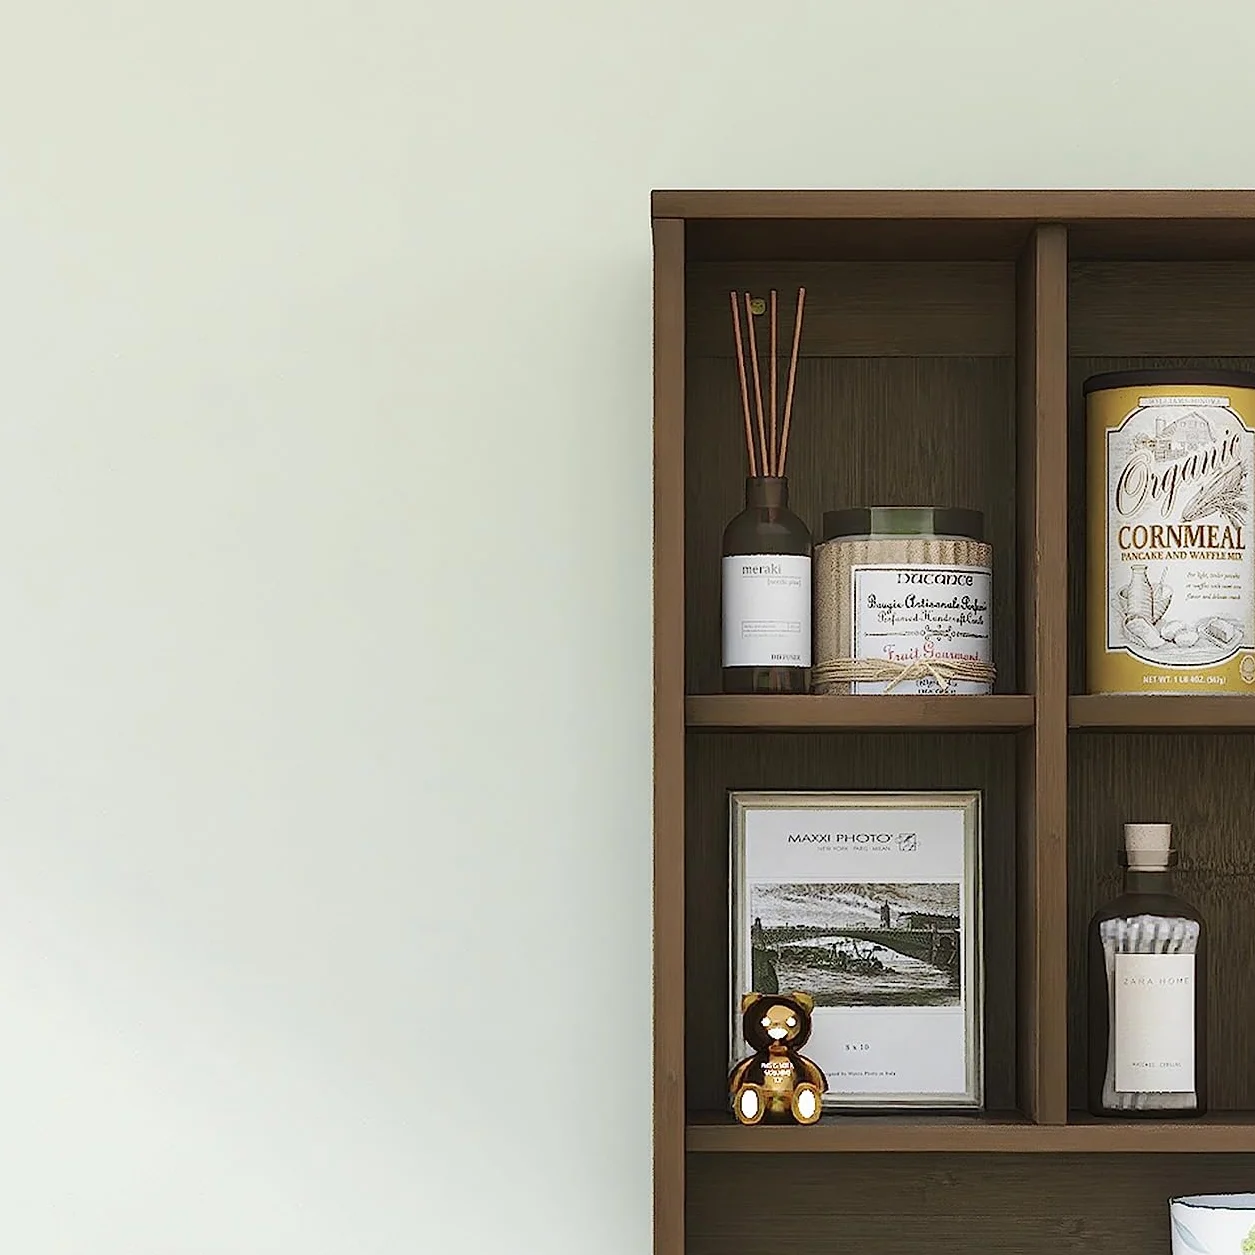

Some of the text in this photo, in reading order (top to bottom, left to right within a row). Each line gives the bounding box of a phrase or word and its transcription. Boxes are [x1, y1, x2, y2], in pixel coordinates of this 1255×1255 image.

[1116, 430, 1241, 519] Organic
[1118, 525, 1246, 550] CORNMEAL
[1121, 551, 1163, 561] PANCAKE
[1165, 551, 1187, 560] AND
[1190, 551, 1226, 561] WAFFLE
[742, 564, 782, 575] meraki
[883, 644, 919, 660] Fruit
[788, 833, 830, 843] MAXXI
